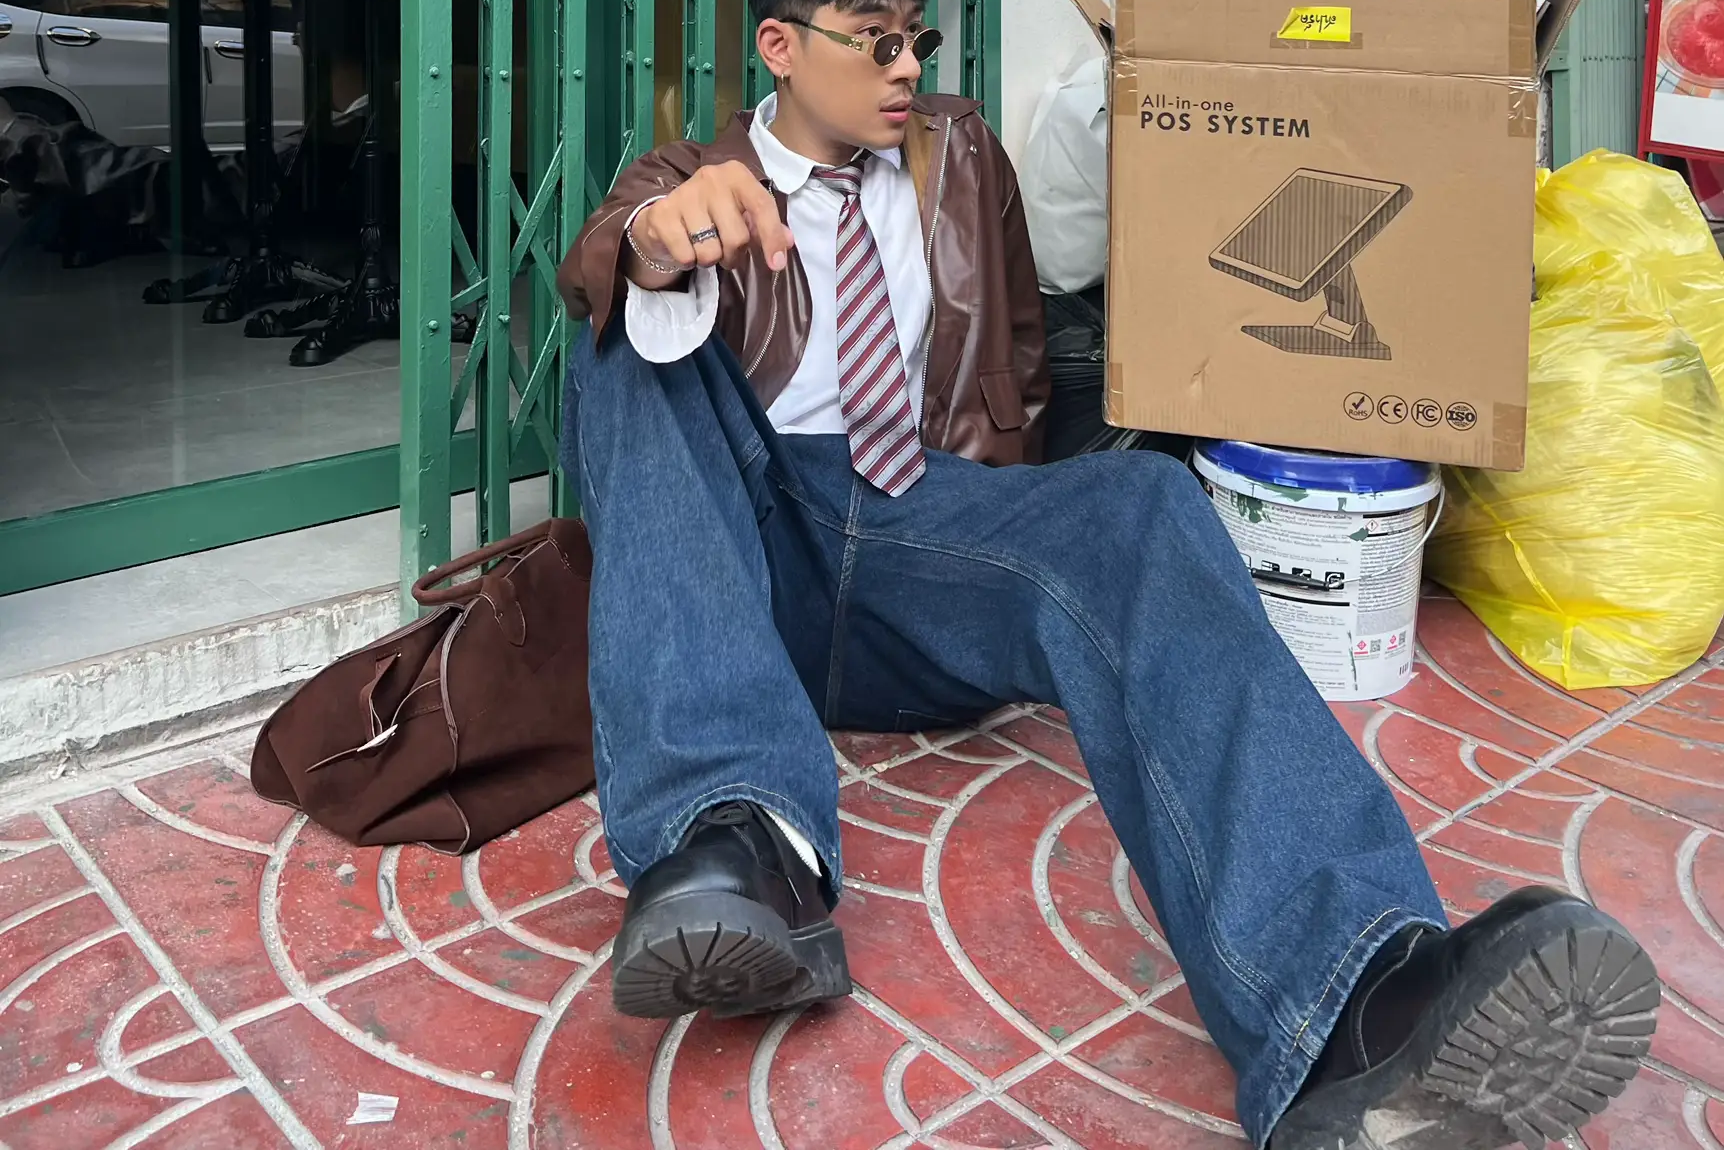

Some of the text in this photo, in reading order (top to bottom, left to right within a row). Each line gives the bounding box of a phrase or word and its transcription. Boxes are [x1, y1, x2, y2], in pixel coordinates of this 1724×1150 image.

[1141, 94, 1235, 112] All-in-one
[1140, 111, 1311, 138] POS SYSTEM
[1448, 410, 1476, 423] ISO
